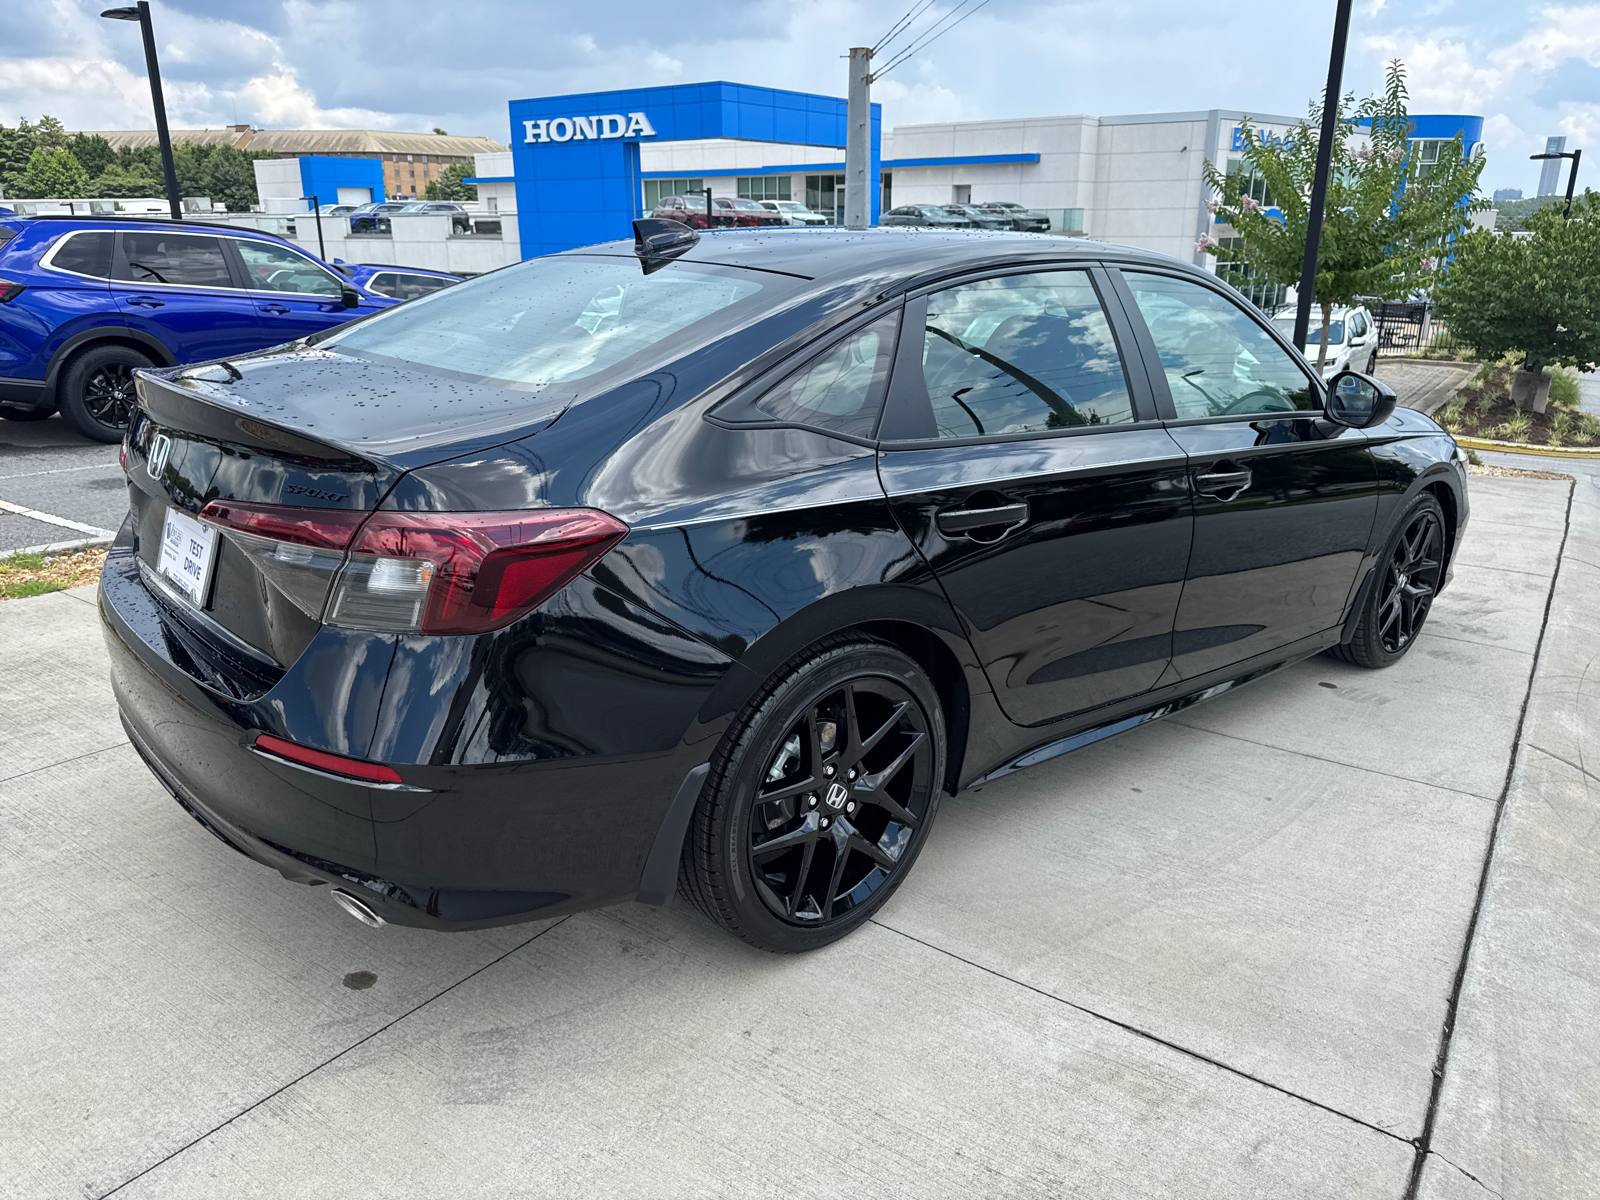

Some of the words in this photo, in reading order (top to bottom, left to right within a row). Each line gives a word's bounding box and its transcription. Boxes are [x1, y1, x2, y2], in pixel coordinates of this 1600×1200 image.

[522, 112, 657, 143] HONDA
[286, 484, 349, 502] SPORT
[190, 538, 204, 559] TEST
[183, 556, 202, 581] DRIVE
[731, 815, 739, 874] ALL-SEASON
